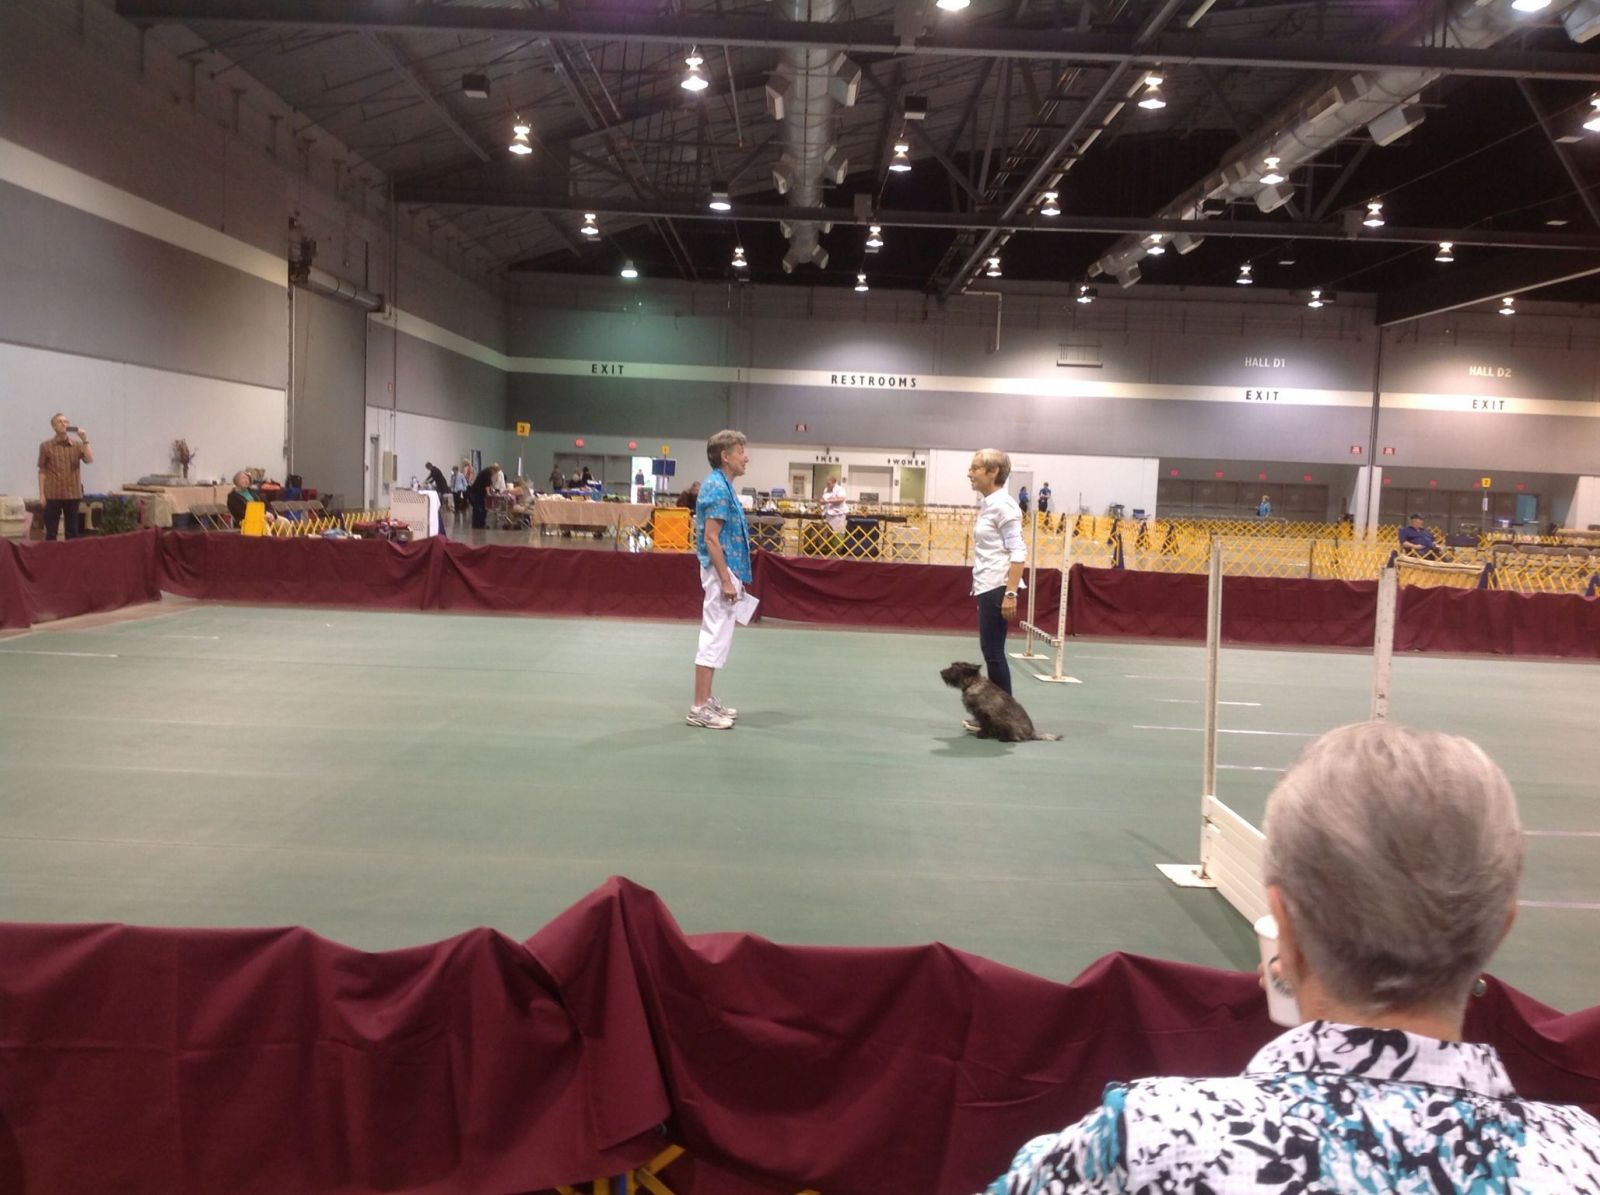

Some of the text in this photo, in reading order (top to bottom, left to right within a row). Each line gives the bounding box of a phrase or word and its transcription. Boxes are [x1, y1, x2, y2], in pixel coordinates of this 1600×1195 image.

[1245, 356, 1286, 368] HALL D1
[591, 363, 624, 375] EXIT
[1469, 365, 1512, 378] HALL D2
[831, 374, 917, 388] RESTROOMS
[1246, 390, 1279, 401] EXIT
[1472, 399, 1505, 411] EXIT
[893, 459, 926, 467] WOMEN
